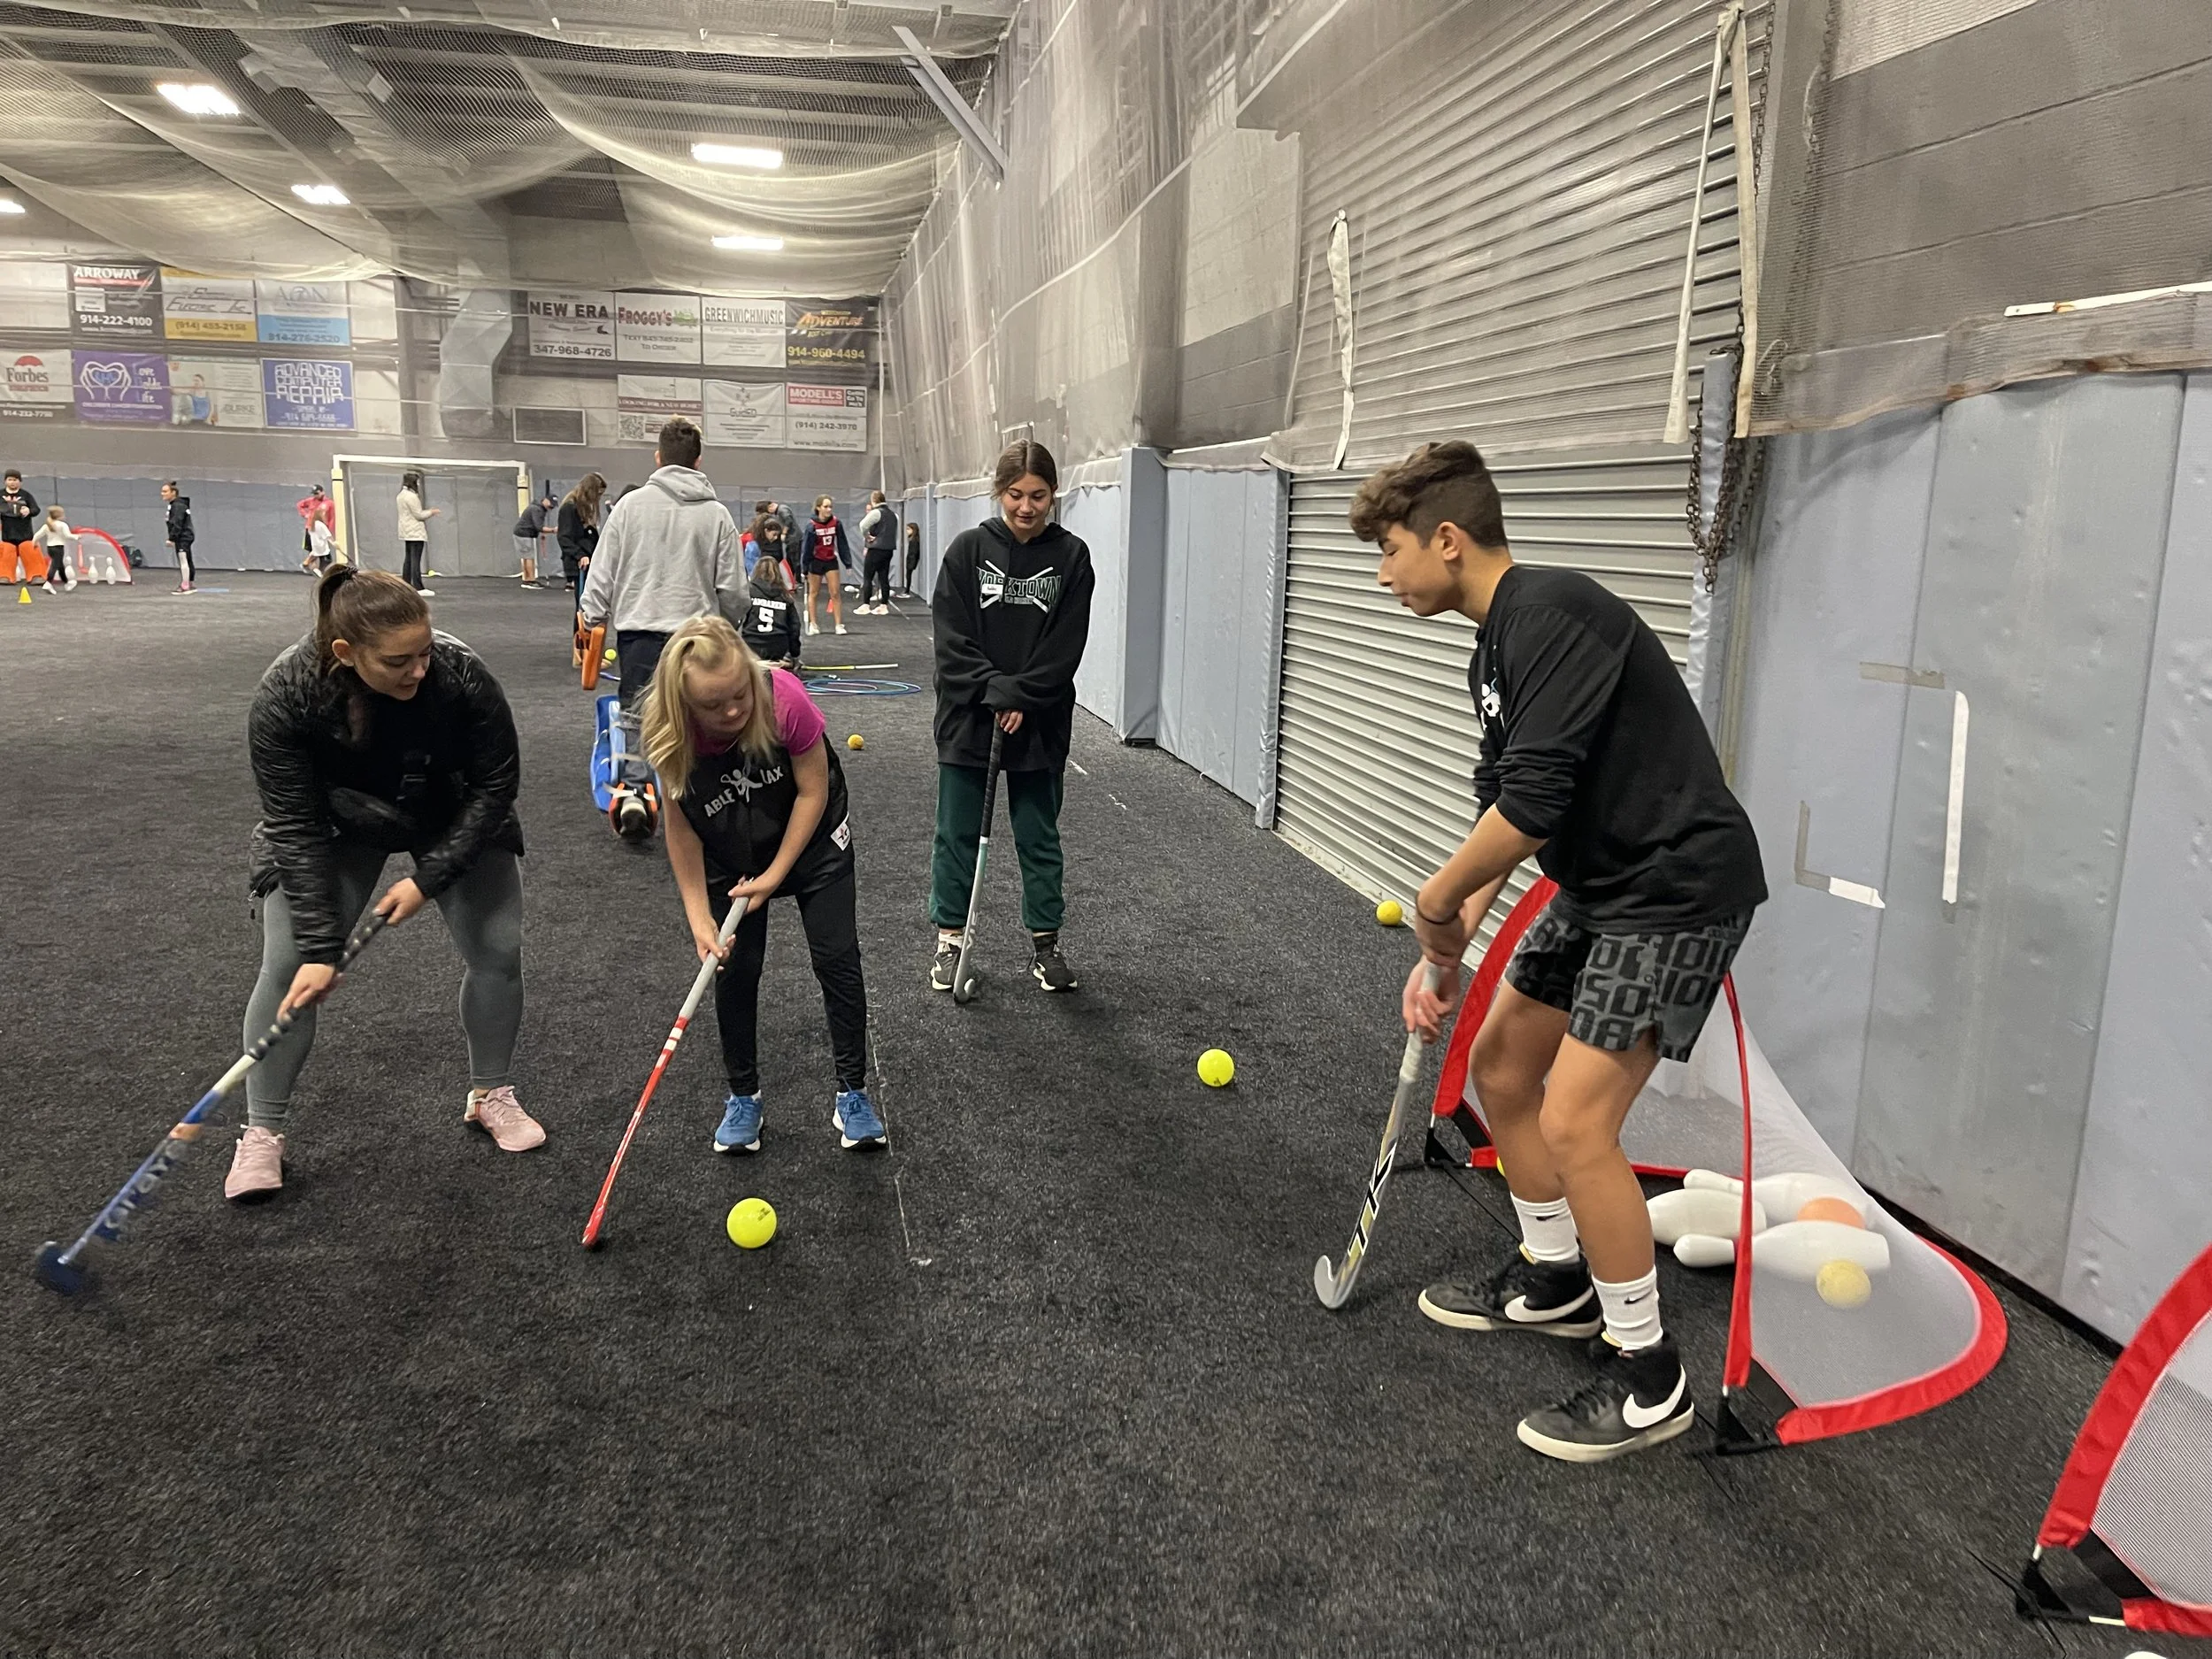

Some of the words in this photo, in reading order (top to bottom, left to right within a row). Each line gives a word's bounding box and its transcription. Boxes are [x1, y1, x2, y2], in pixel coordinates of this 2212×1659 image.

[73, 266, 141, 280] ARROWAY
[530, 302, 568, 317] NEW
[576, 304, 610, 319] ERA
[80, 314, 153, 326] 914-222-4100
[534, 344, 612, 357] 347-968-4726
[6, 367, 49, 382] Forbes
[275, 363, 342, 378] ADVANCED
[276, 385, 343, 404] REPAIR
[789, 388, 842, 400] MODELL'S
[757, 607, 774, 633] 5
[704, 788, 736, 818] ABLE
[759, 765, 785, 785] LAX
